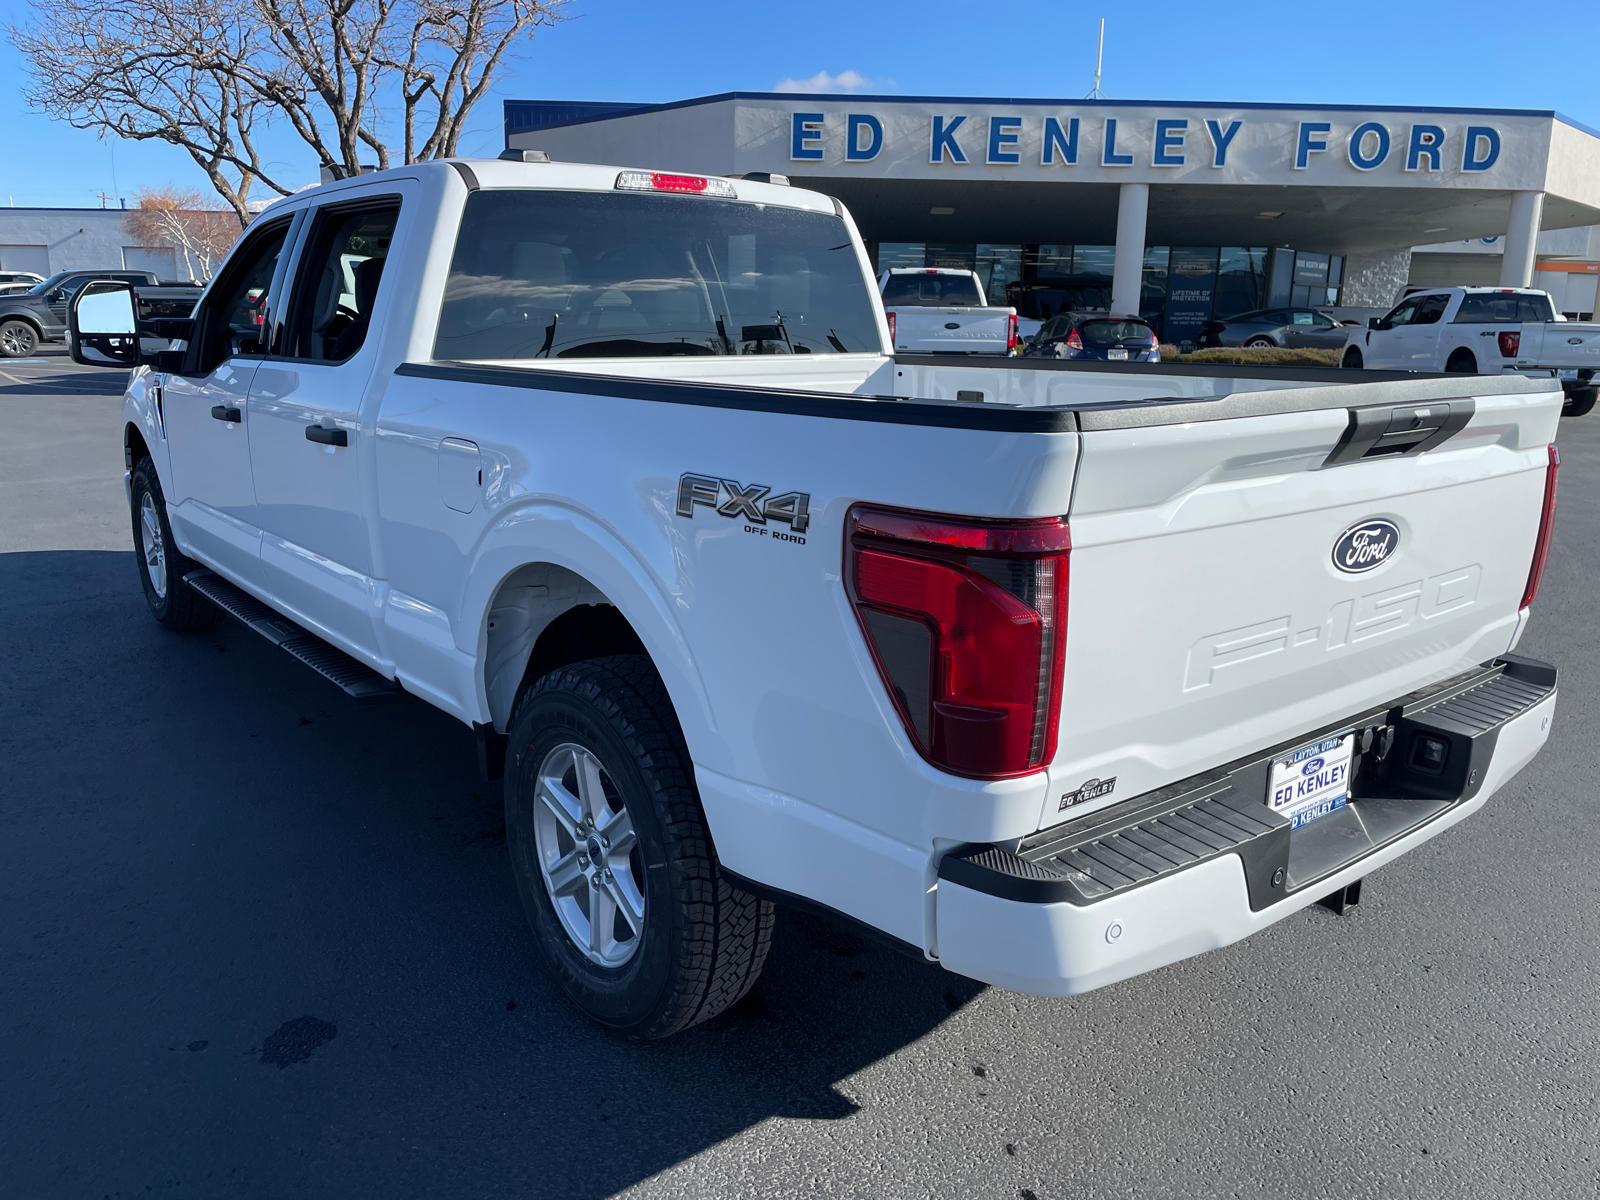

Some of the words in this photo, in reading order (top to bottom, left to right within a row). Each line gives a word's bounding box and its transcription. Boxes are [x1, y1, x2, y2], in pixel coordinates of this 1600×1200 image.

[790, 112, 885, 163] ED
[929, 114, 1247, 169] KENLEY
[1291, 120, 1503, 174] FORD
[676, 472, 810, 534] FX4
[744, 525, 768, 536] OFF
[772, 531, 806, 546] ROAD
[1343, 525, 1393, 568] Ford
[1182, 562, 1484, 694] F-150
[1321, 737, 1338, 752] UTAH
[1274, 785, 1293, 807] ED
[1296, 762, 1348, 798] KENLEY
[1304, 758, 1323, 776] Ford
[1060, 795, 1075, 809] ED
[1076, 781, 1115, 803] KENLEY
[1300, 799, 1334, 826] KENLEY
